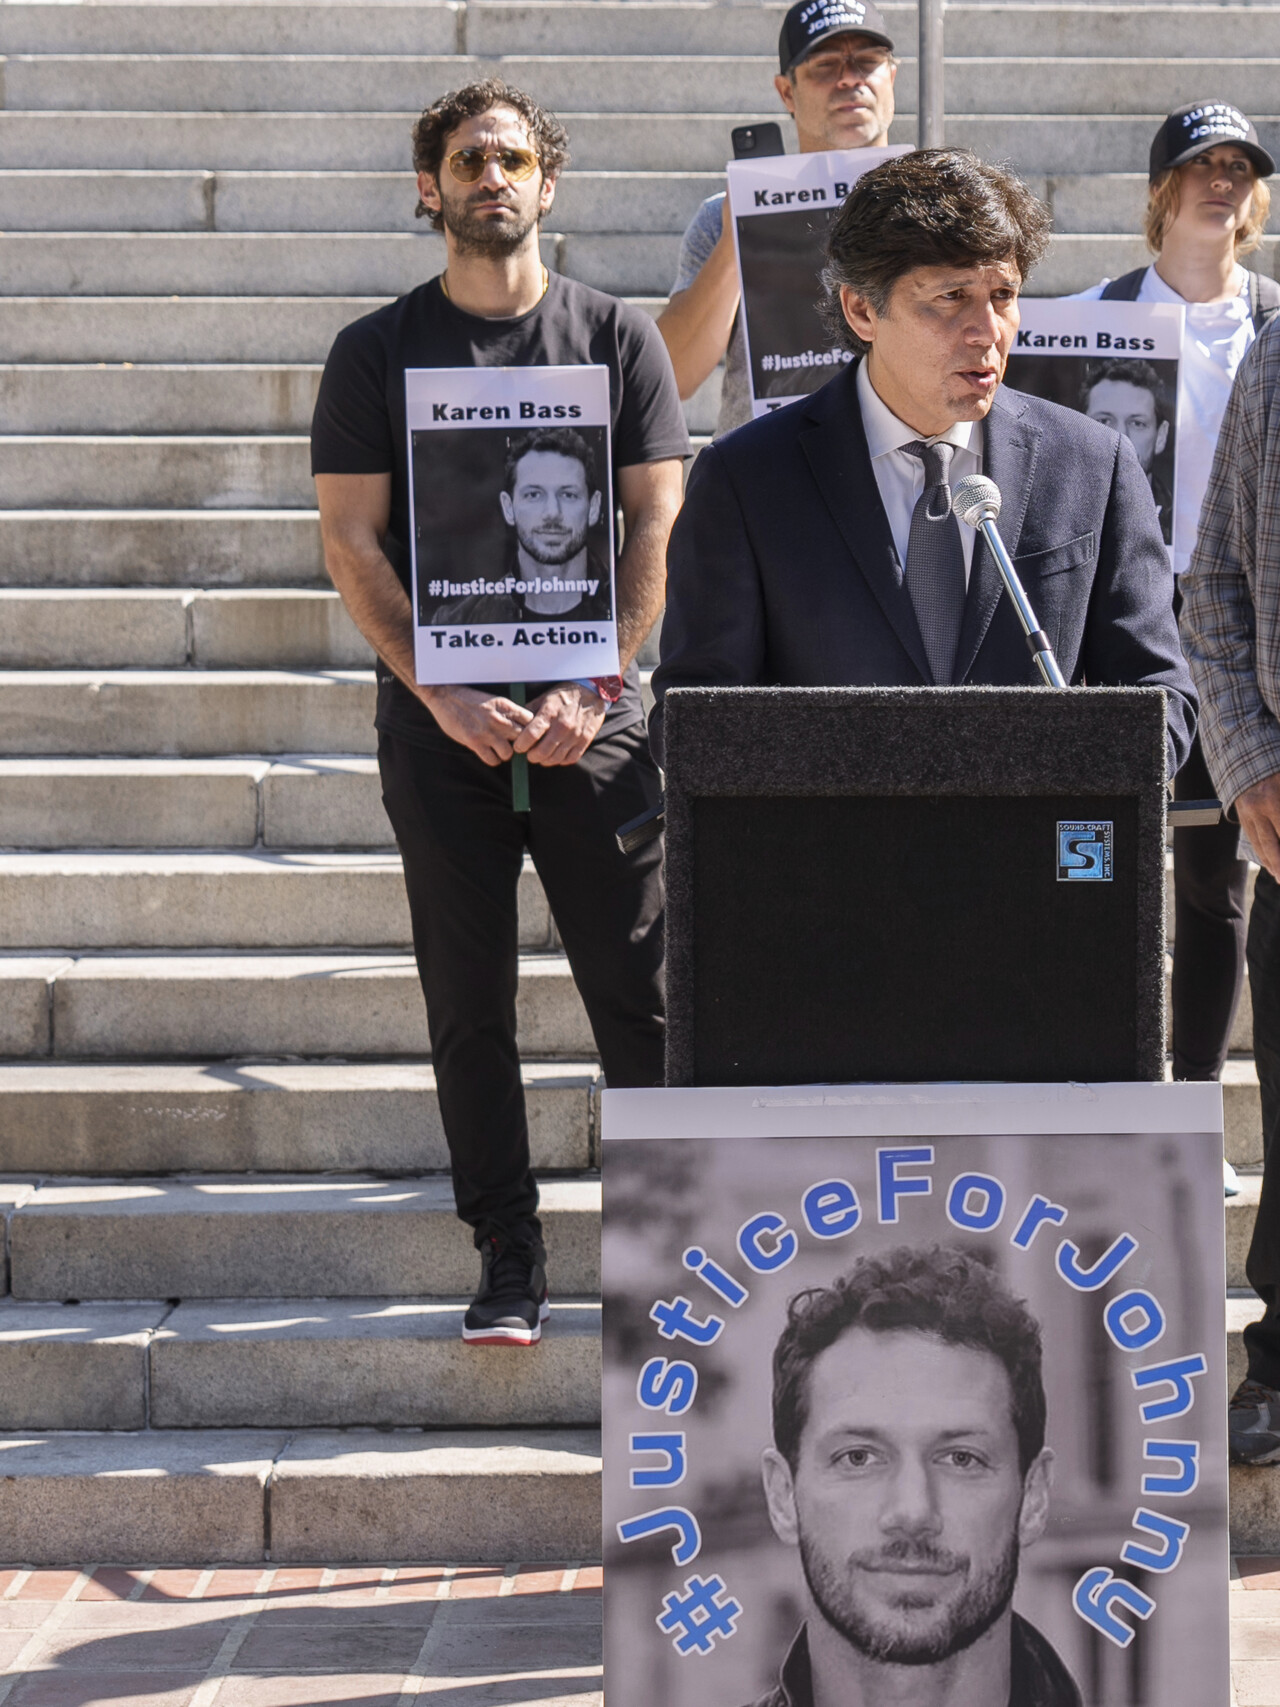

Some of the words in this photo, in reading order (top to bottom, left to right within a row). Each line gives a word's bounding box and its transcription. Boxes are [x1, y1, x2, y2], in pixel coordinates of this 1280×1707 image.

[807, 13, 864, 34] JOHNNY
[1182, 104, 1250, 127] JUSTICE
[1189, 124, 1247, 140] JOHNNY
[754, 188, 827, 207] Karen
[1017, 330, 1087, 348] Karen
[1096, 332, 1155, 351] Bass
[762, 348, 855, 371] #JusticeFo
[432, 403, 510, 421] Karen
[519, 401, 582, 419] Bass
[428, 577, 599, 597] #JusticeForJohnny
[430, 630, 503, 649] Take.
[512, 626, 607, 647] Action.
[617, 1146, 1207, 1655] #JusticeForJohnny
